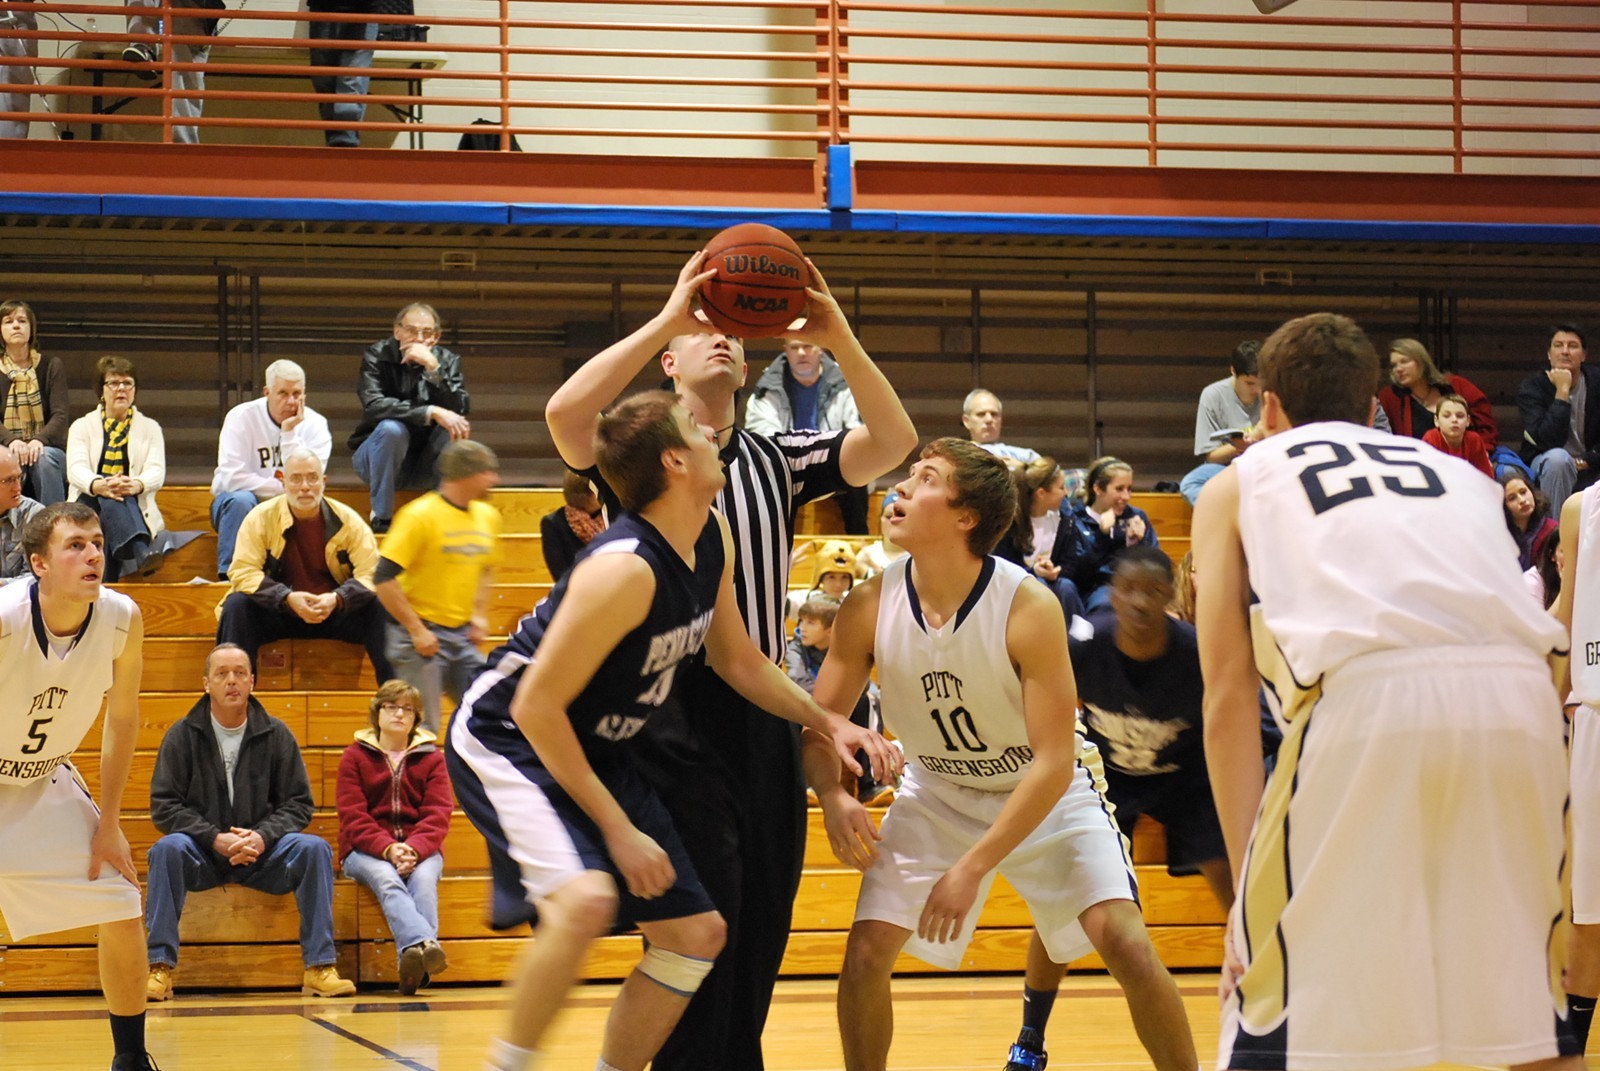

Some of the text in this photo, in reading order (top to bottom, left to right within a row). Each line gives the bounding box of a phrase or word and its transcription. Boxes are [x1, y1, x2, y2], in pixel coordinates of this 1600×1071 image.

[724, 254, 800, 280] Wilson
[732, 293, 789, 312] NCAA
[1286, 440, 1446, 516] 25
[27, 686, 69, 716] PITT
[921, 670, 963, 702] PITT
[20, 716, 54, 754] 5
[930, 705, 988, 753] 10
